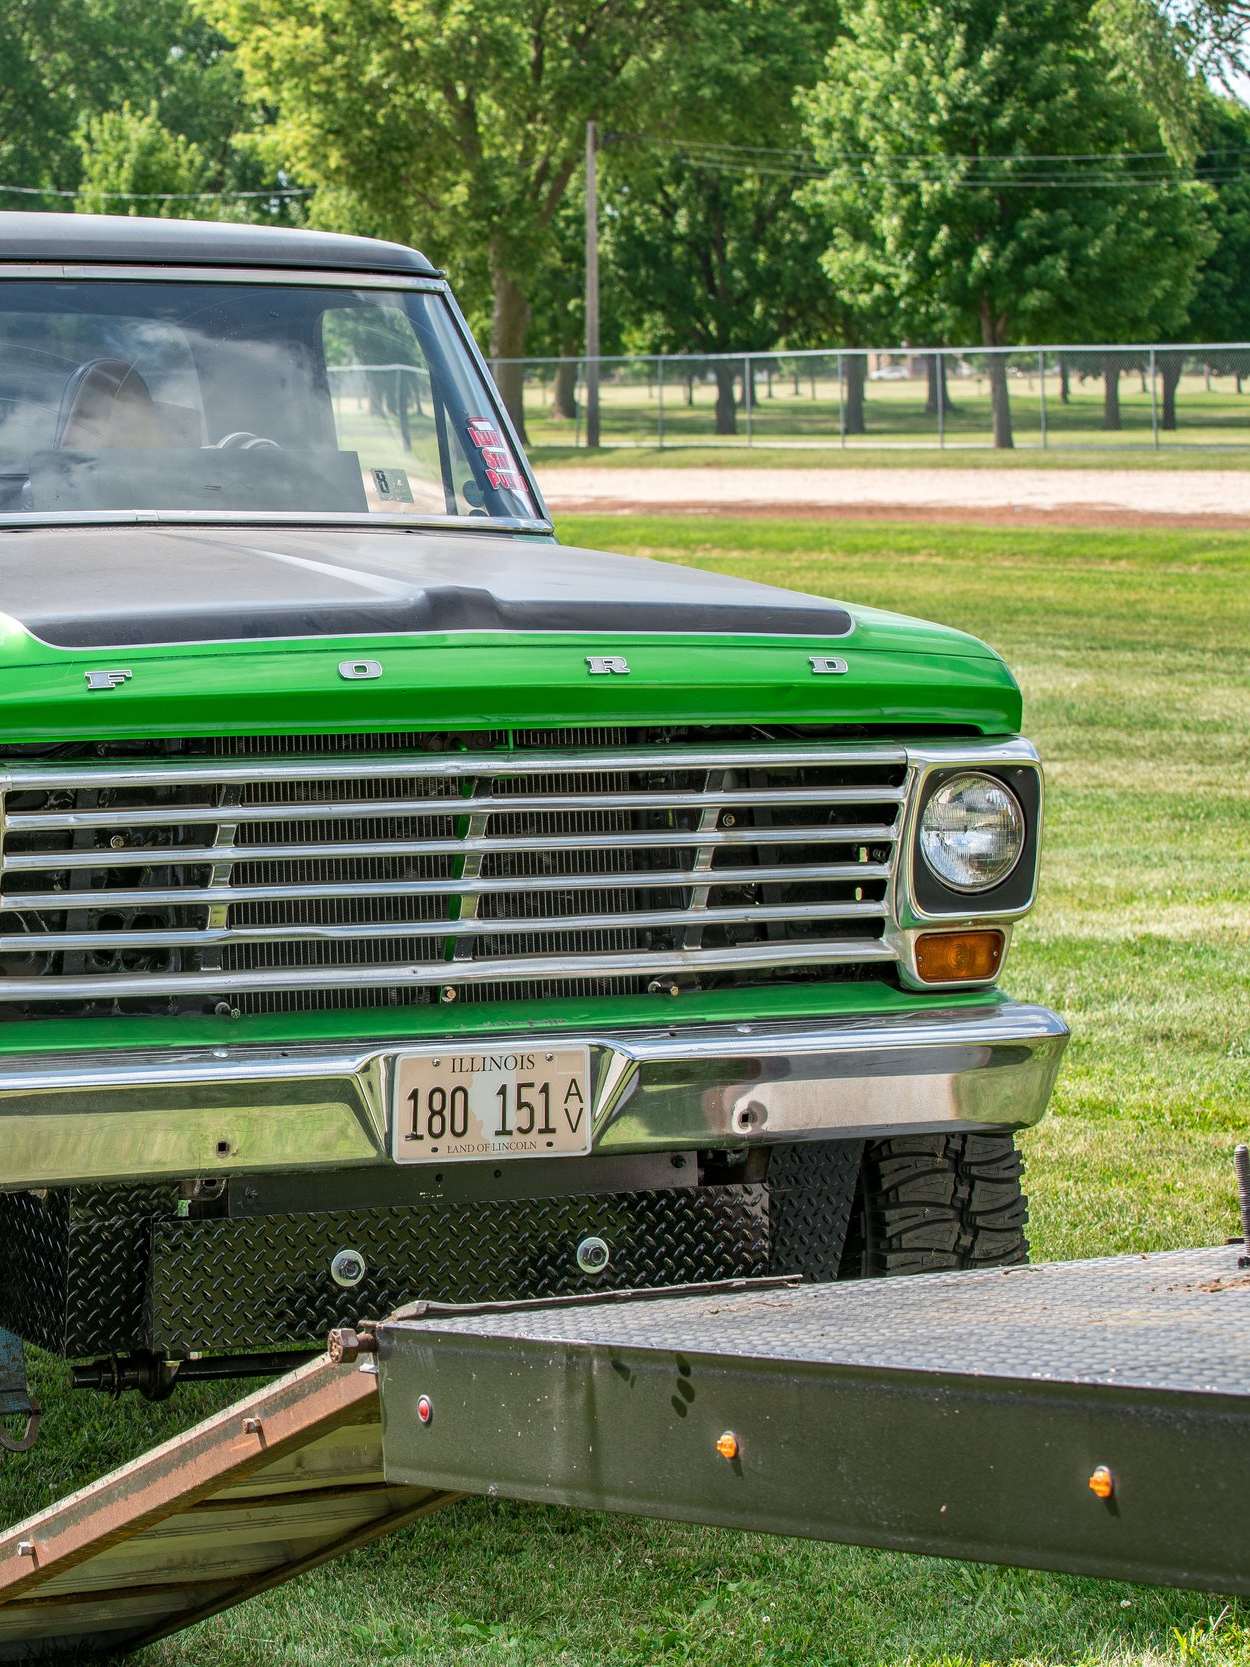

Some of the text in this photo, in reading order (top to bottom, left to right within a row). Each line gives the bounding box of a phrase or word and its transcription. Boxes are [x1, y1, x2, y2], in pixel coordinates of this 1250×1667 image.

[451, 1054, 535, 1074] ILLINOIS
[405, 1081, 557, 1142] 180 151
[447, 1141, 537, 1154] LAND OF LINCOLN
